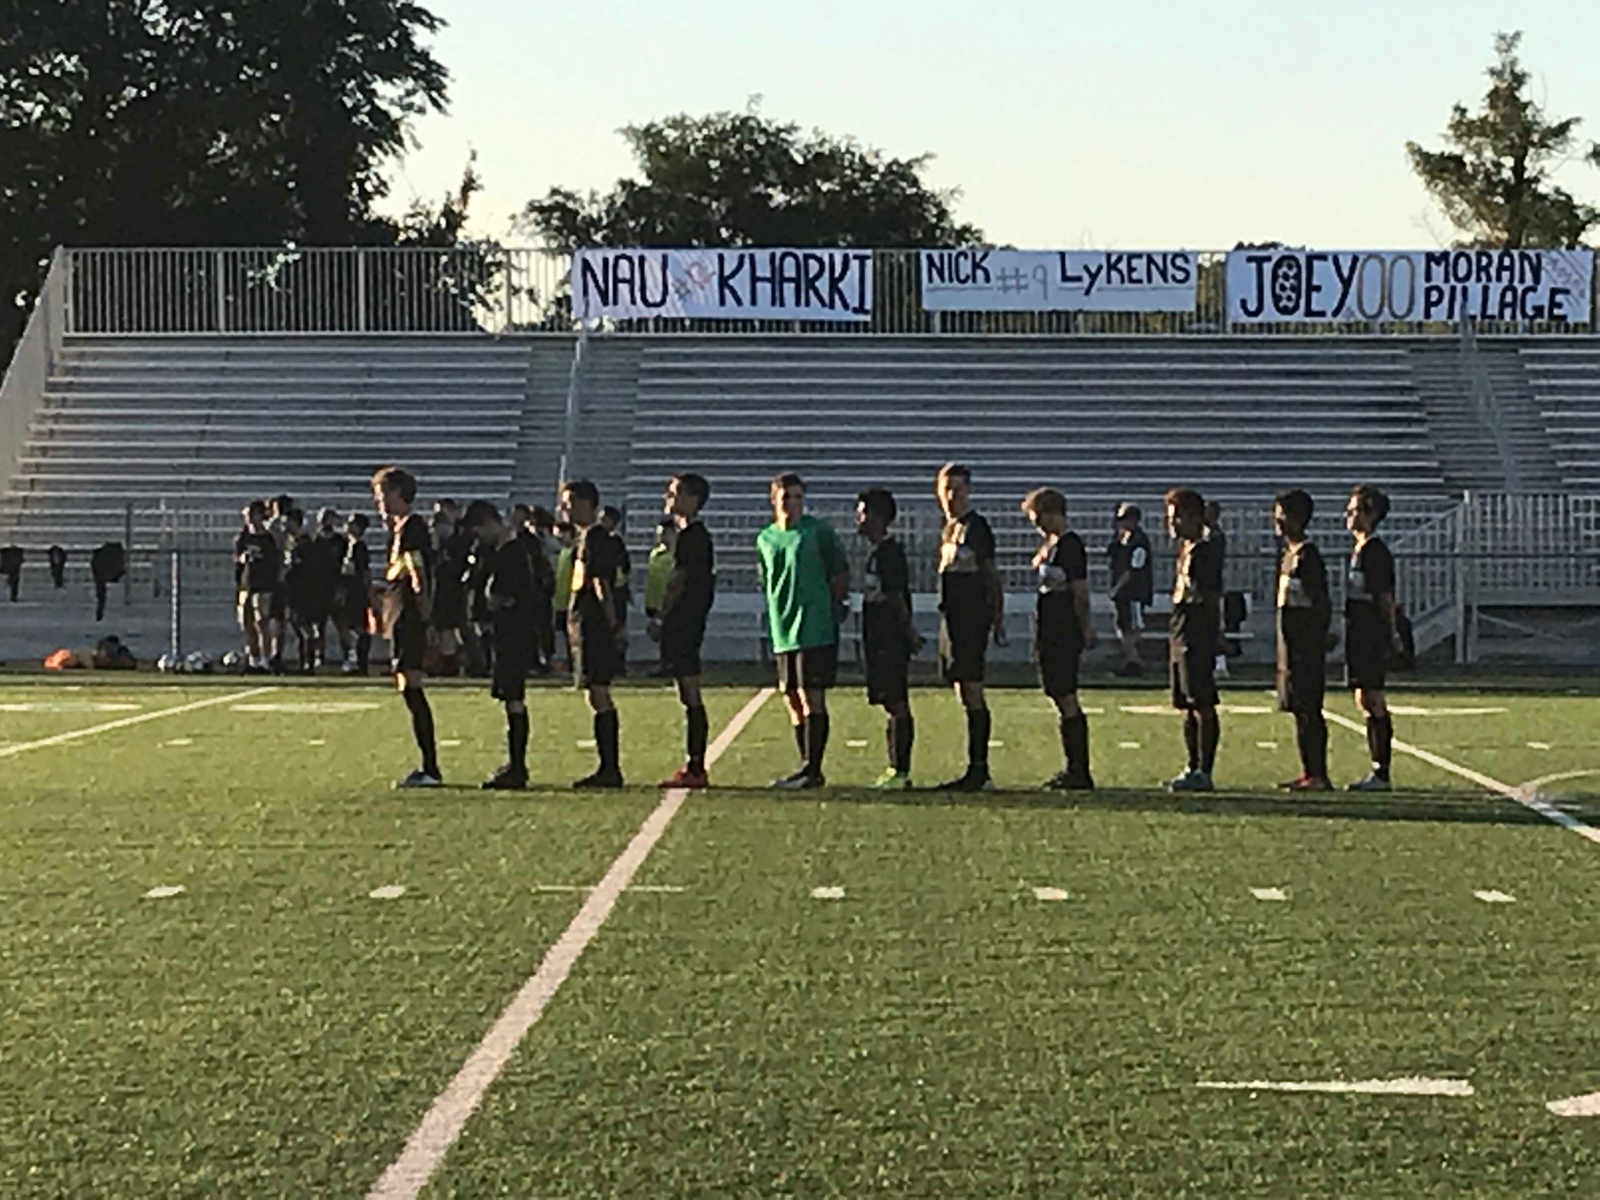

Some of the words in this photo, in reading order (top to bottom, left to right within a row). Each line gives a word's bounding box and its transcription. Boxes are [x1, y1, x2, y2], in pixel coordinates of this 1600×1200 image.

[580, 253, 668, 312] NAU
[718, 251, 871, 314] KHARKI
[926, 252, 991, 284] NICK
[1424, 251, 1542, 285] MORAN
[1424, 285, 1571, 320] PILLAGE
